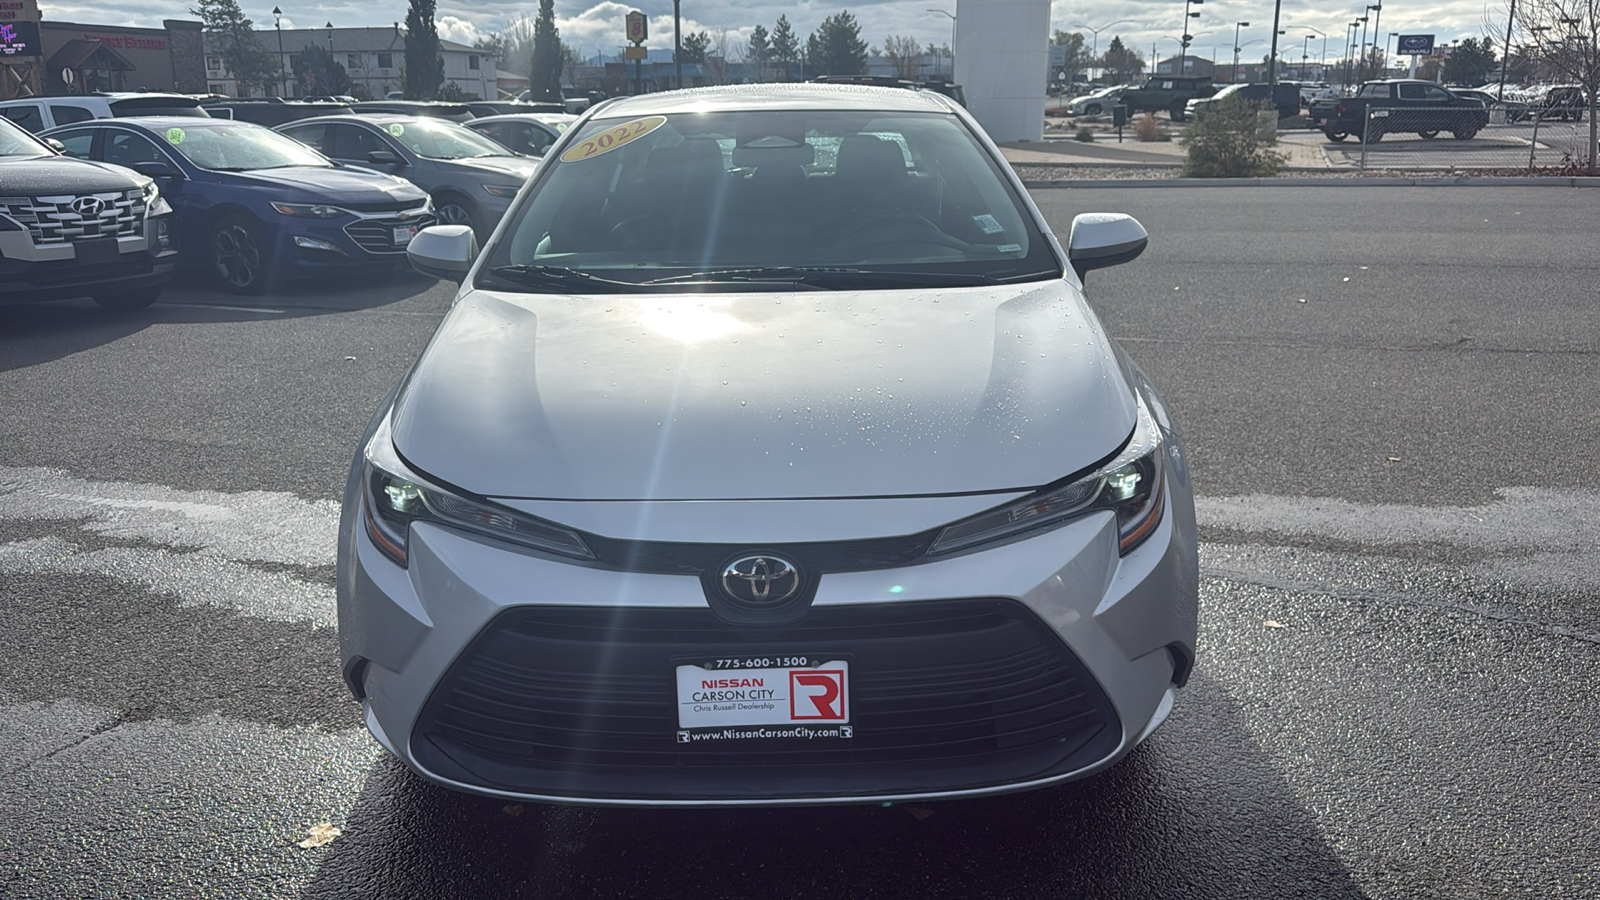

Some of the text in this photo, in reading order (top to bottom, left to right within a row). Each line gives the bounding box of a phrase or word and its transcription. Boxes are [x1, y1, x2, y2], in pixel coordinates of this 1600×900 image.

[581, 121, 646, 156] 2022
[716, 657, 808, 668] 775-600-1500
[701, 678, 764, 689] NISSAN
[692, 689, 774, 702] CARSON CITY
[693, 702, 775, 713] Chris Russell Dealership
[692, 727, 838, 740] www.NissanCarsonCity.com
